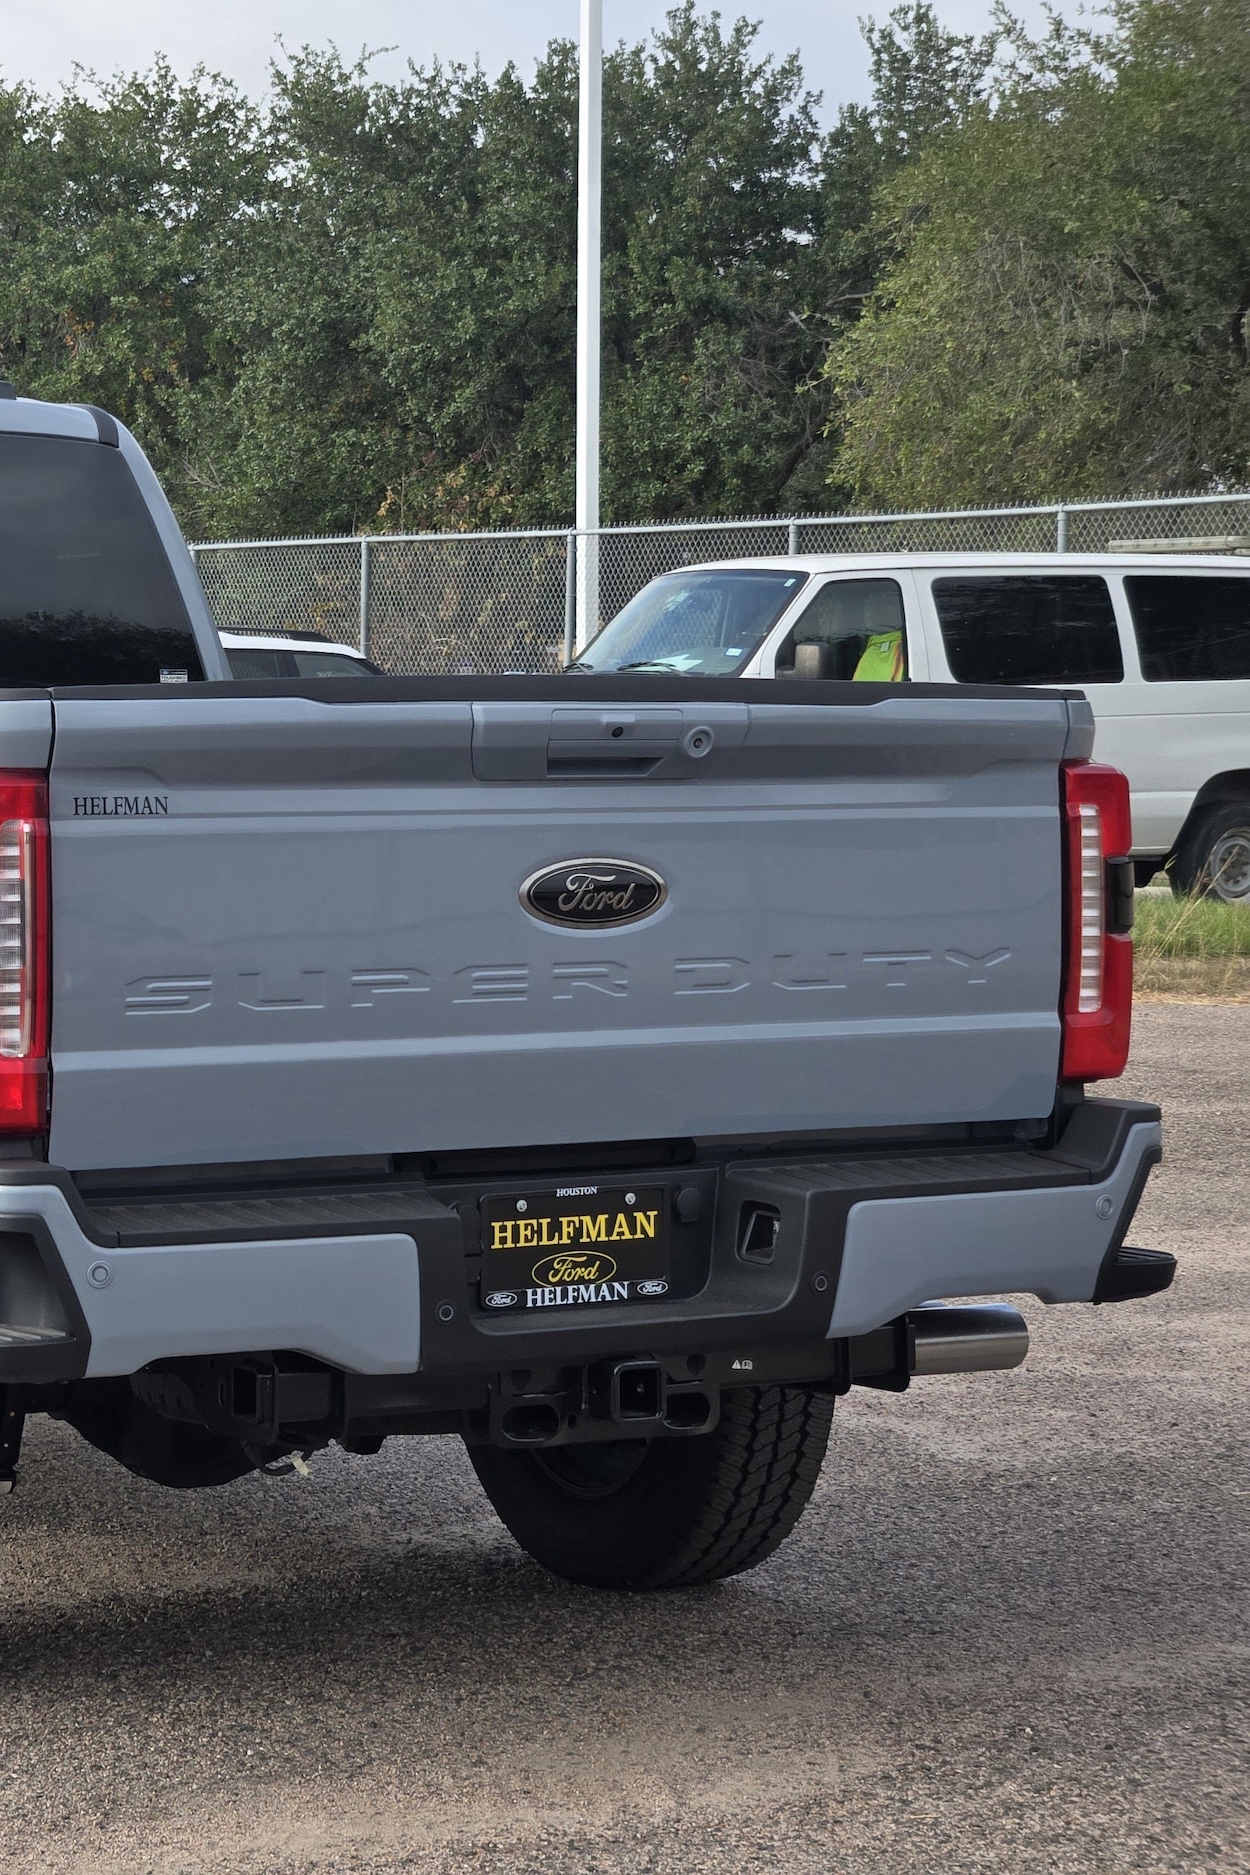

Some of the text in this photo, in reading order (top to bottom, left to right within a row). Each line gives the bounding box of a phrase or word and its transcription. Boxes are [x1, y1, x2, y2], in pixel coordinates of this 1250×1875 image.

[73, 796, 169, 816] HELFMAN
[557, 873, 637, 912] Ford
[125, 945, 1013, 1016] SUPER DUTY
[555, 1186, 598, 1198] HOUSTON
[490, 1210, 659, 1250] HELFMAN
[548, 1255, 601, 1283] Ford
[525, 1281, 630, 1308] HELFMAN
